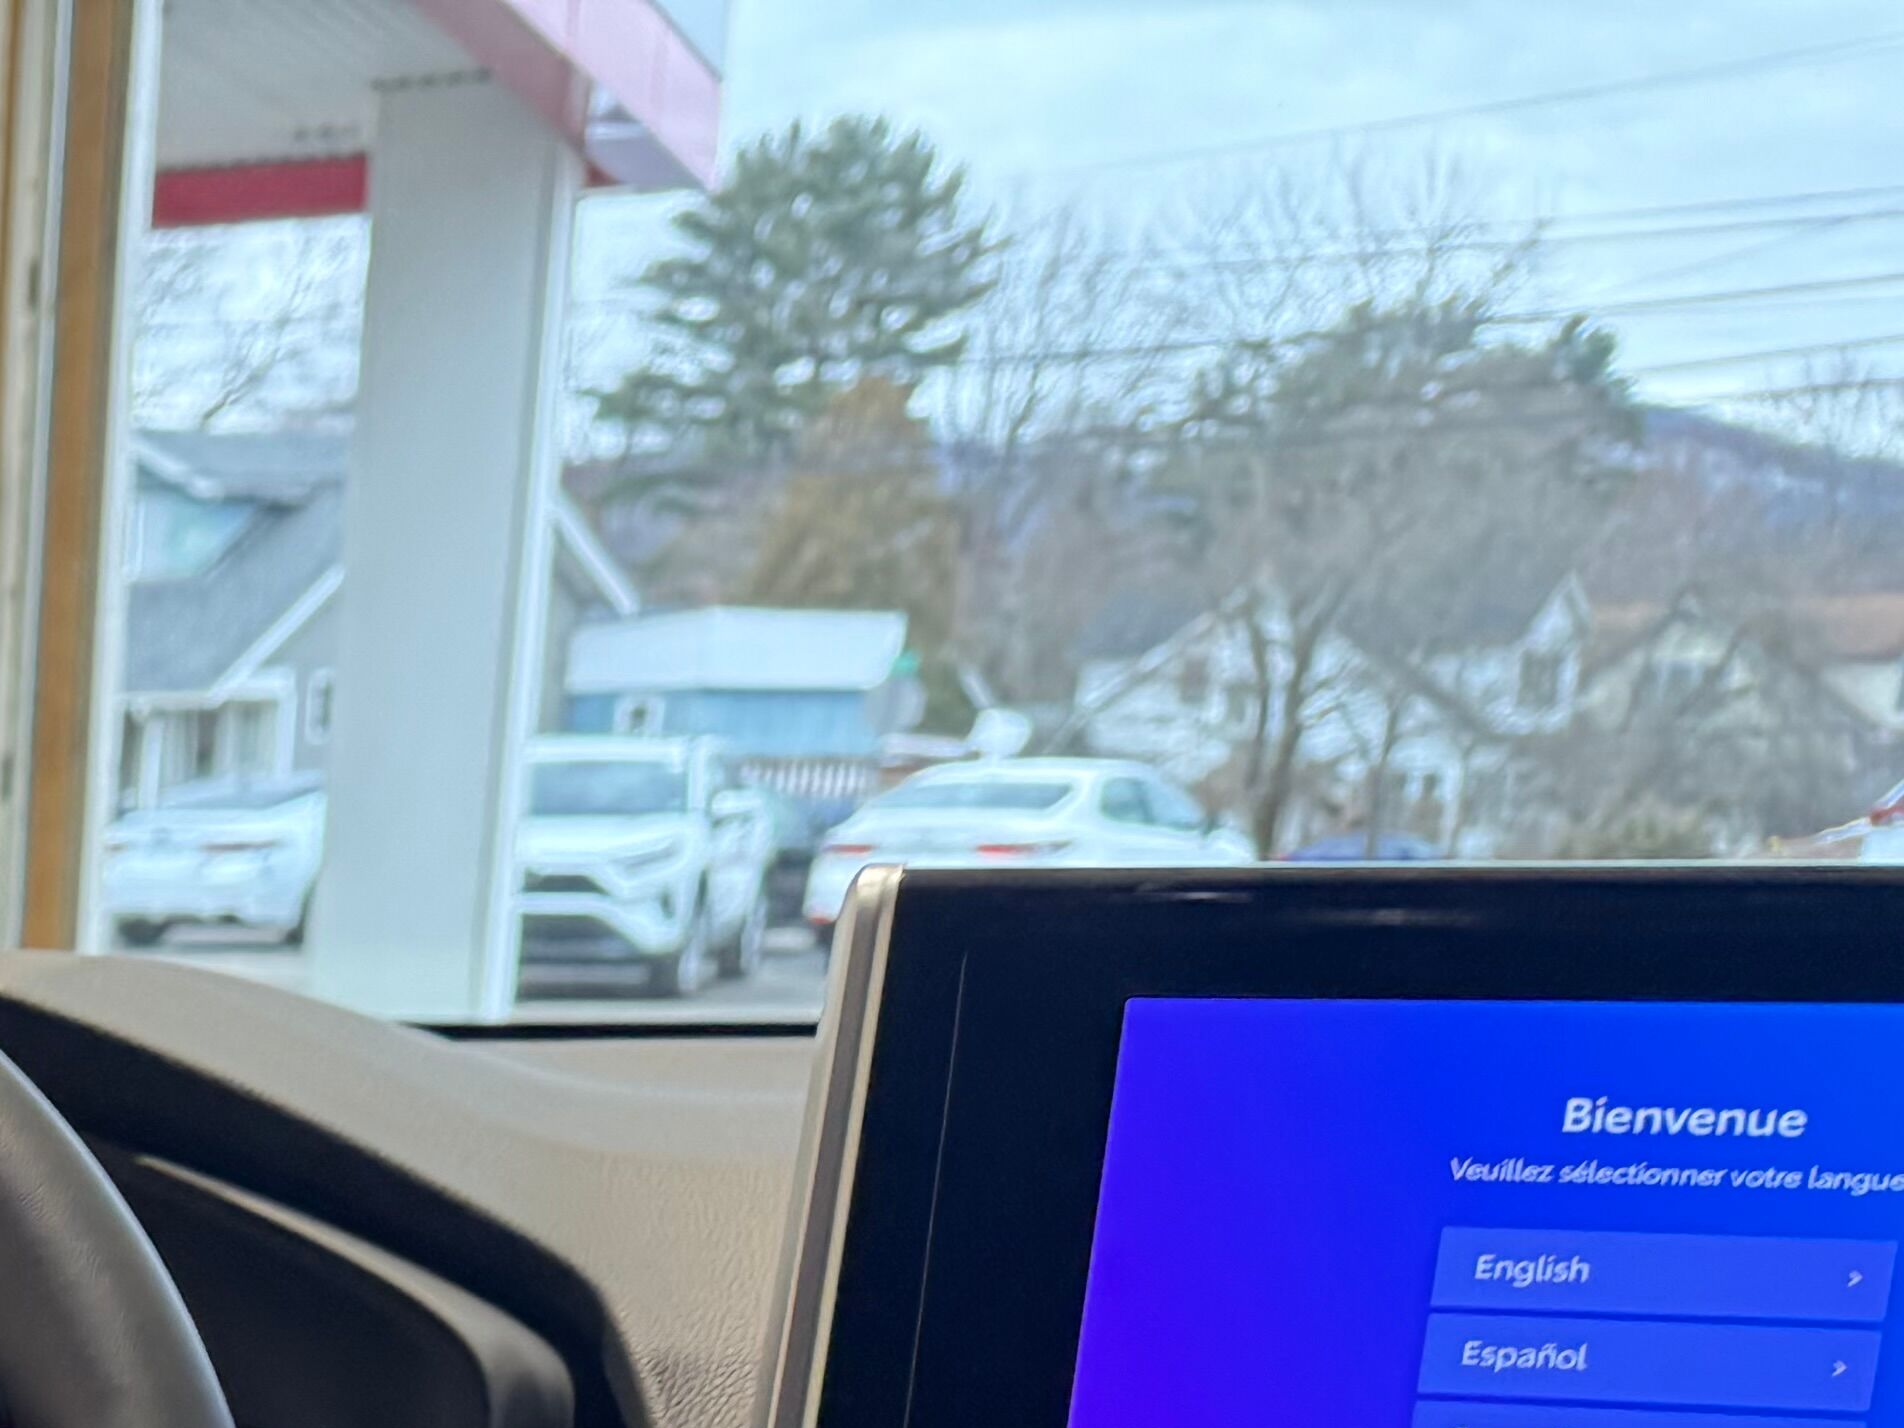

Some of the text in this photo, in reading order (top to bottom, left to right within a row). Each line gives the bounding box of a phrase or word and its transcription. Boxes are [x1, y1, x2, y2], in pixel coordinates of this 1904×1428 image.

[1562, 1096, 1808, 1137] Bienvenue
[1450, 1157, 1904, 1197] Veuillez sélectionner votre langue
[1474, 1254, 1590, 1288] English
[1461, 1340, 1588, 1373] Español
